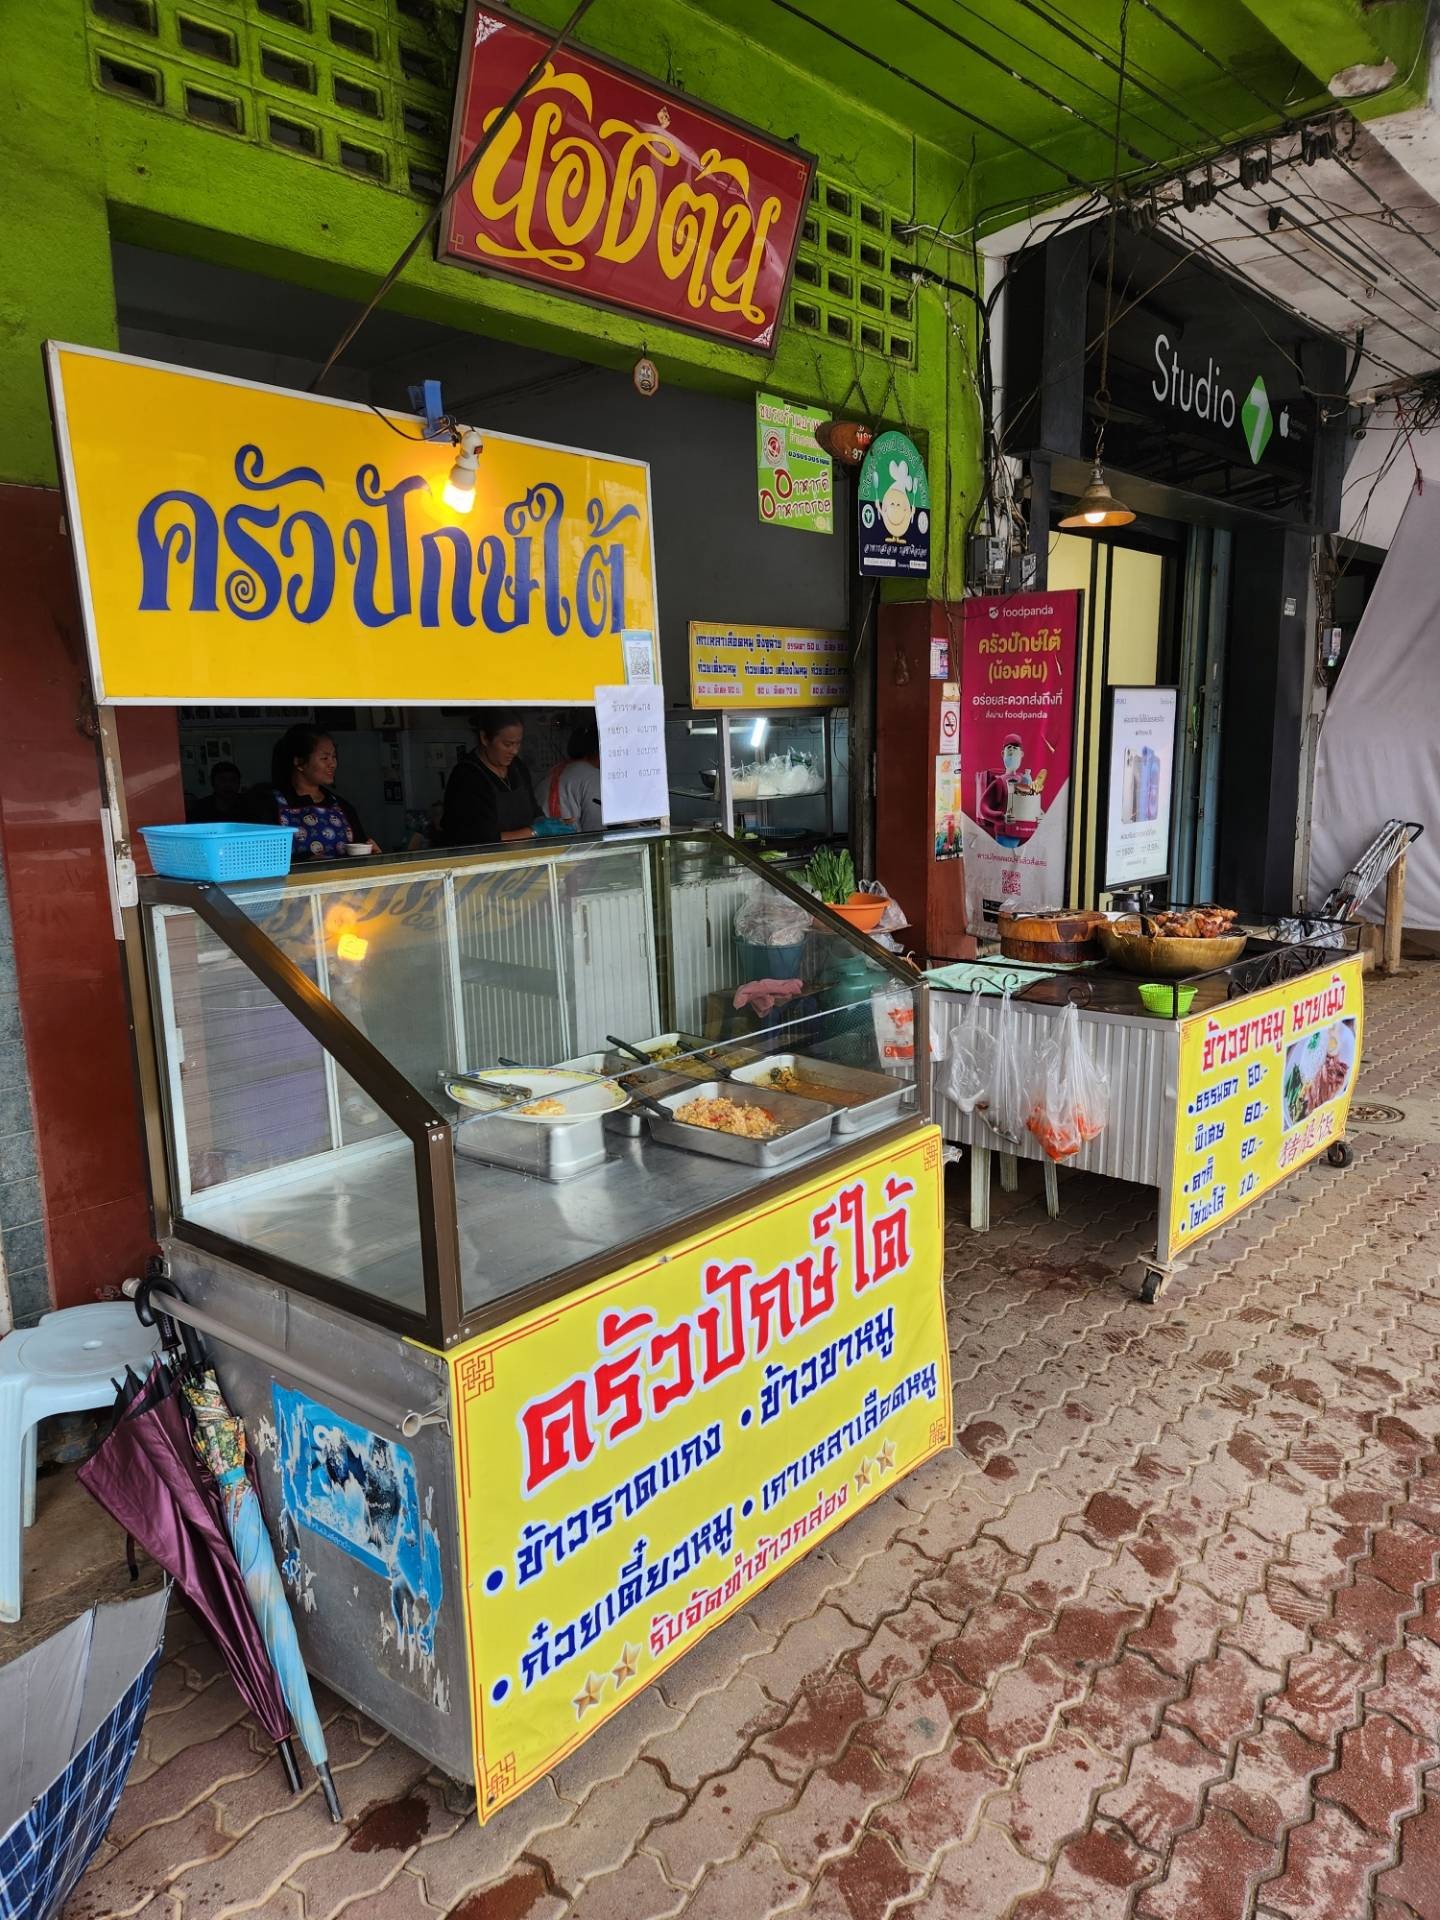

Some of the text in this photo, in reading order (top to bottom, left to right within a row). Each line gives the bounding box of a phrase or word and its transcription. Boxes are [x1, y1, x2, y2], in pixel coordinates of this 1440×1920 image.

[472, 61, 782, 324] น้องต้น
[1152, 334, 1236, 429] Studio
[138, 443, 641, 637] ครัวปักษ์ใต้
[1003, 604, 1053, 618] foodpanda
[978, 628, 1062, 654] ครัวปักษ์ใต้
[988, 658, 1048, 684] (น้องต้น)
[972, 688, 1063, 706] อร่อยสะดวกส่งถึงที่
[1005, 710, 1048, 721] foodpanda
[1202, 974, 1346, 1071] ข้าวขาหมู นายเม้ง
[1195, 1078, 1239, 1113] ธรรมดา
[1195, 1123, 1225, 1151] พิเศษ
[1192, 1156, 1214, 1193] คากิ
[1189, 1185, 1226, 1230] ไข่พะโล้
[522, 1178, 914, 1492] ครัวปักษ์ใต้
[517, 1307, 895, 1586] ข้าวราดแกง ข้าวขาหมู
[522, 1361, 938, 1688] ก๋วยเตี๋ยวหมู เกาเหลาเลือดหมู
[649, 1483, 848, 1657] รับจัดทำข้าวกล่อง
